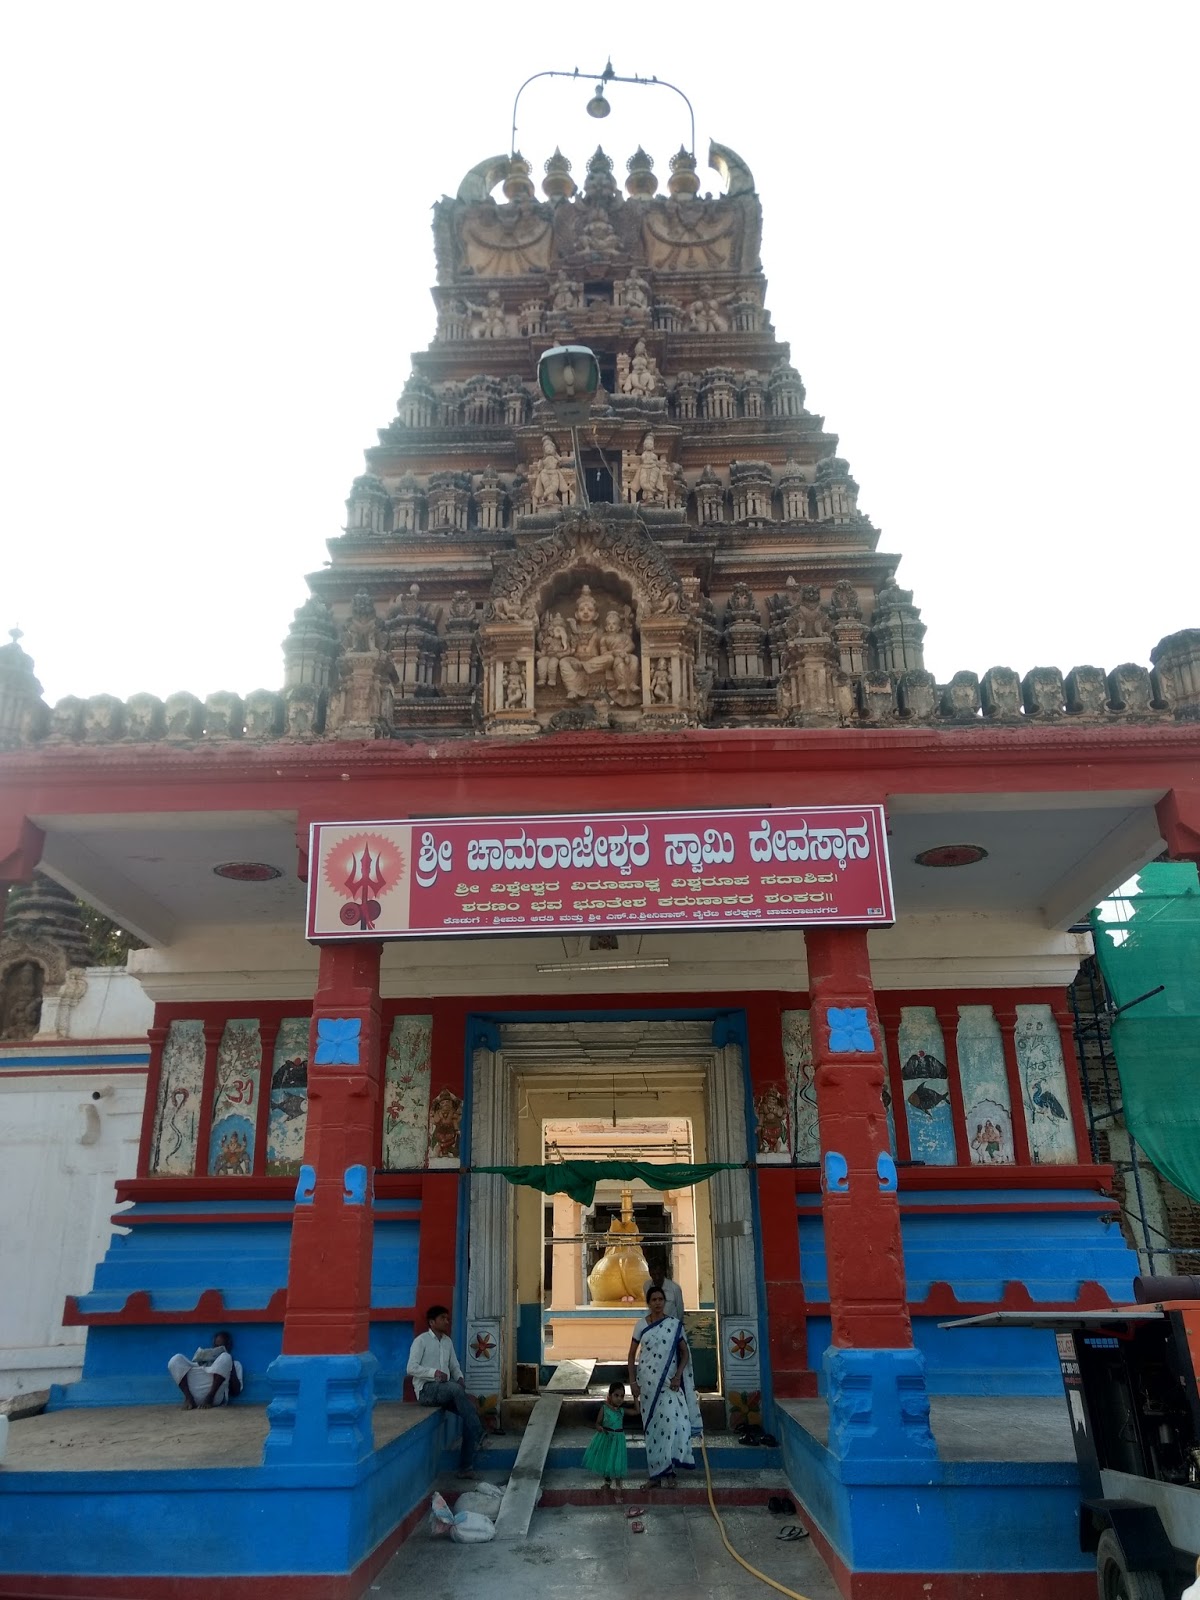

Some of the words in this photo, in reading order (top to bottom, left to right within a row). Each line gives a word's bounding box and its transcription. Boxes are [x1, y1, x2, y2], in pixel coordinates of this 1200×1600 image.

[415, 831, 453, 888] ಶ್ರೀ
[467, 824, 649, 876] ಚಾಮರಾಜೇಶ್ವರ
[664, 828, 735, 874] ಸ್ವಾಮಿ
[748, 815, 870, 871] ದೇವಸ್ಥಾನ
[453, 883, 480, 897] ಶ್ರೀ
[490, 881, 560, 897] ವಿಶ್ವೇಶ್ವರ
[570, 876, 661, 893] ವಿರೂಪಾಕ್ಷ
[670, 873, 750, 892] ವಿಶ್ವರೂಪ
[461, 901, 520, 912] ಶರಣಂ
[530, 899, 563, 912] ಭವ
[573, 896, 647, 911] ಭೂತೇಶ
[656, 892, 754, 907] ಕರುಣಾಕರ
